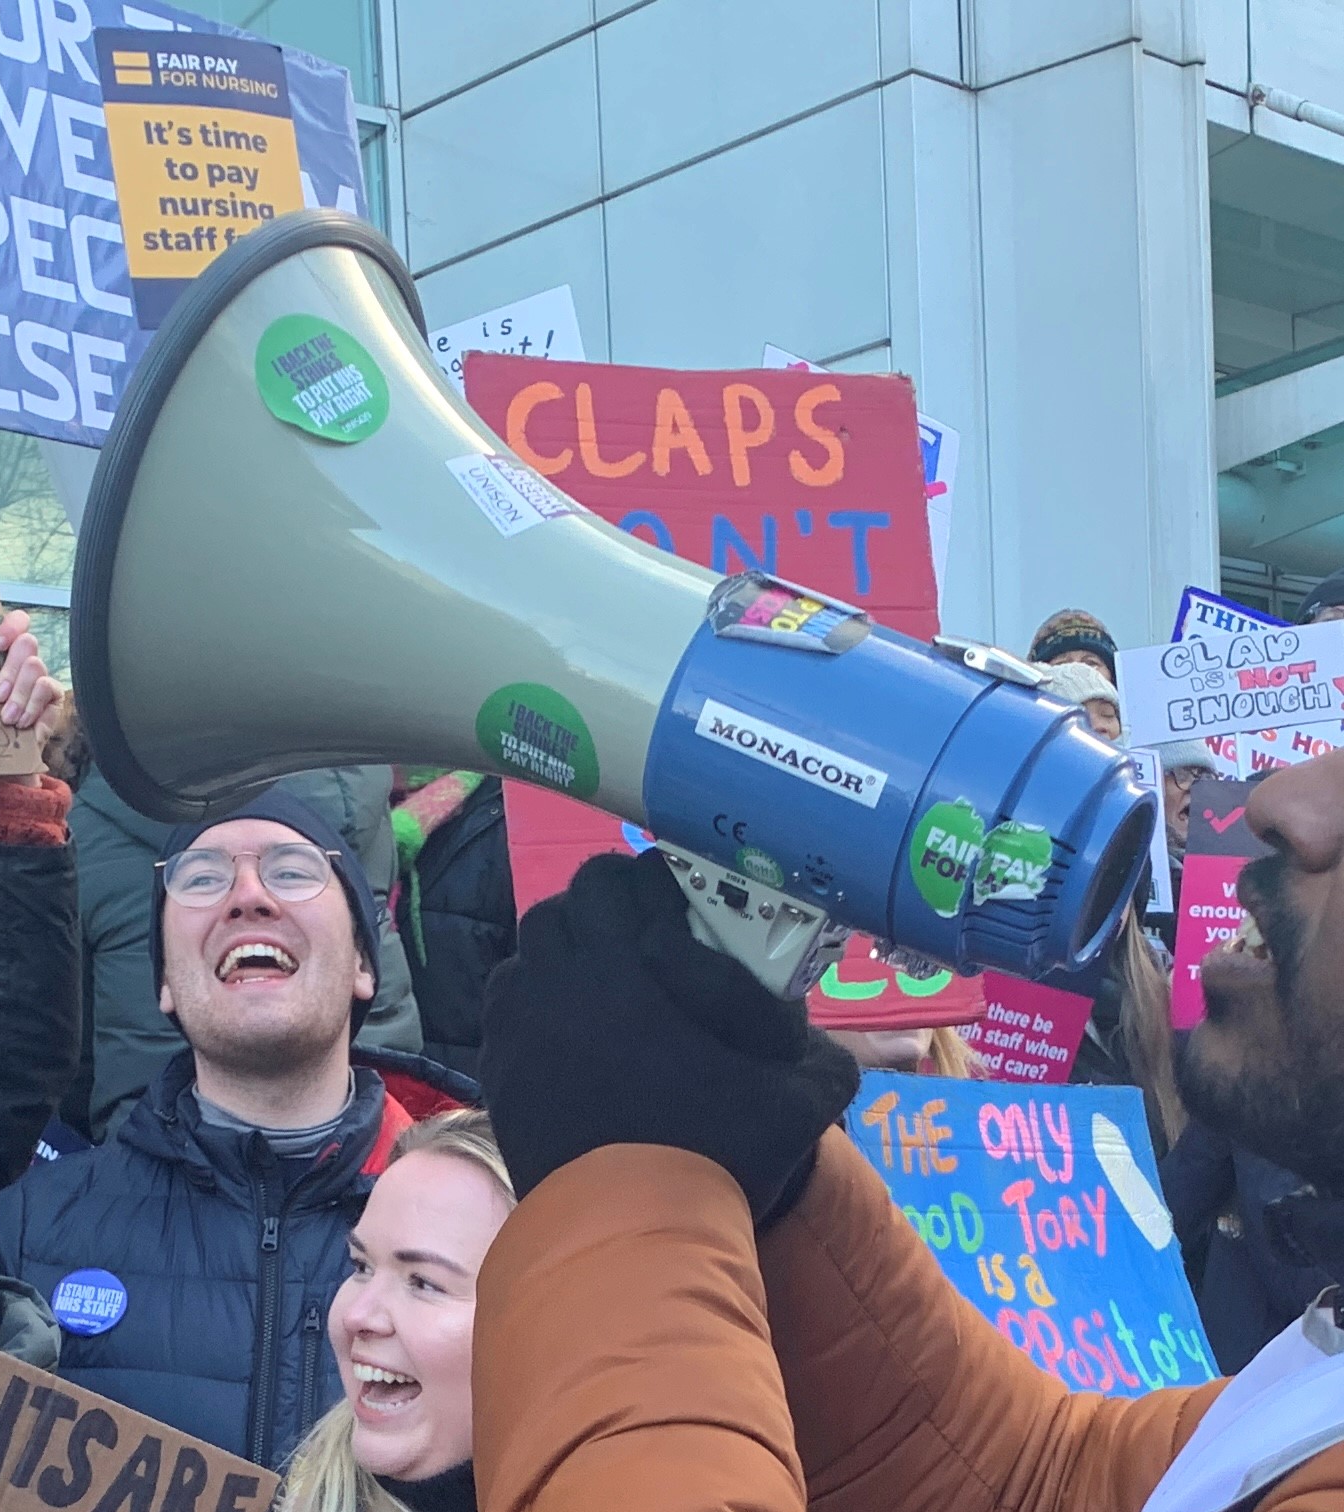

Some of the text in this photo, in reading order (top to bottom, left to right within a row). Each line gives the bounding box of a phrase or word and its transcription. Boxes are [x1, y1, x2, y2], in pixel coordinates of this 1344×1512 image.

[156, 52, 238, 75] FAIR PAY
[160, 71, 279, 99] FOR NURSING
[144, 120, 268, 153] It's time
[165, 157, 260, 189] to pay
[159, 193, 276, 222] nursing
[143, 225, 219, 252] staff
[482, 318, 513, 337] is
[278, 344, 315, 374] BACK
[309, 332, 337, 355] THE
[290, 351, 343, 391] STRIKES
[292, 363, 363, 413] TO PUT NHS
[309, 381, 373, 429] PAY RIGHT
[506, 381, 845, 487] CLAPS
[468, 467, 523, 523] UNISON
[1161, 631, 1300, 680] CLAP
[1191, 659, 1317, 693] IS NOT
[514, 704, 553, 738] BACK
[500, 730, 575, 780] TO PUT NHS
[503, 747, 570, 788] PAY RIGHT
[990, 852, 1044, 883] PAY
[707, 896, 718, 907] ON
[740, 911, 755, 921] OFF
[987, 1002, 1054, 1034] there be
[984, 1028, 1025, 1050] staff
[1025, 1039, 1069, 1063] when
[1004, 1058, 1049, 1080] care?
[862, 1090, 957, 1177] THE
[56, 1298, 120, 1319] NHS STAFF
[65, 1283, 97, 1299] STAND
[97, 1287, 124, 1303] WITH
